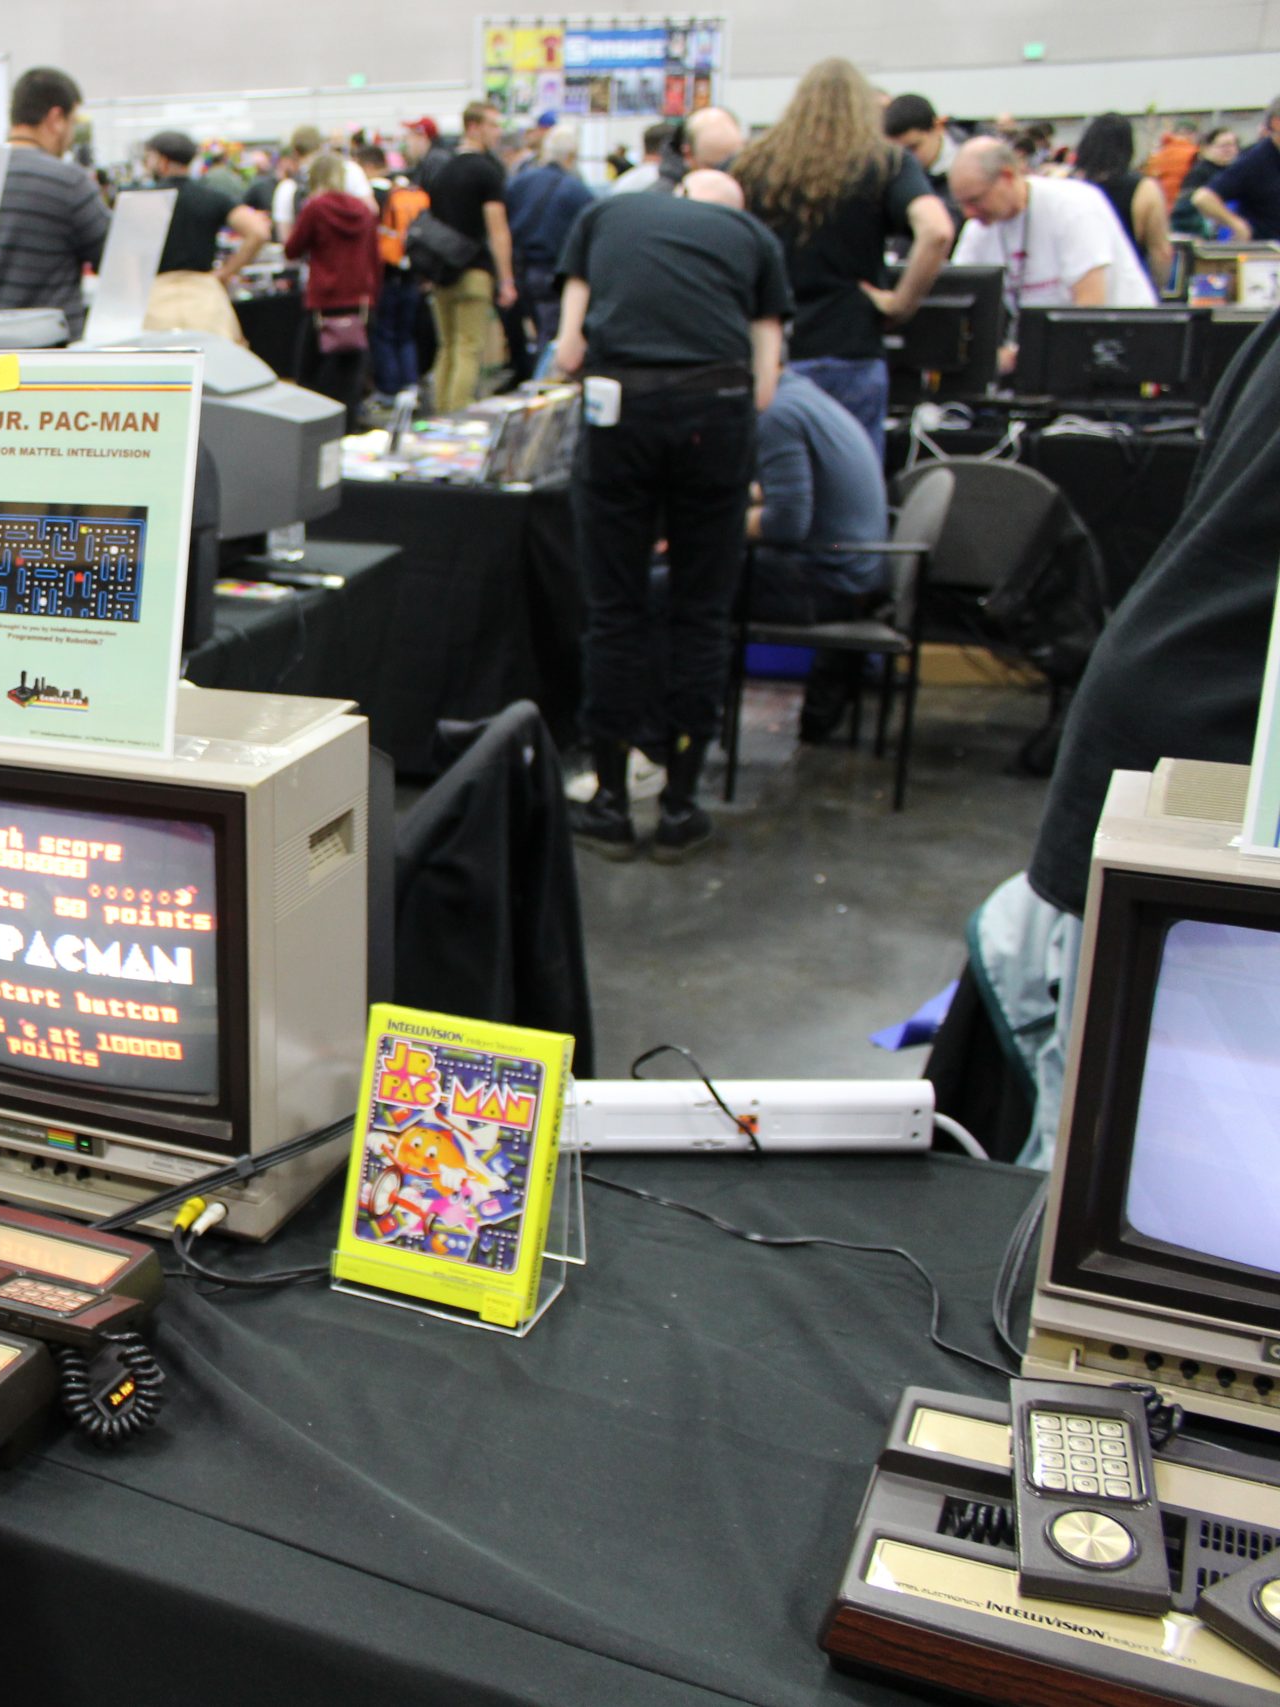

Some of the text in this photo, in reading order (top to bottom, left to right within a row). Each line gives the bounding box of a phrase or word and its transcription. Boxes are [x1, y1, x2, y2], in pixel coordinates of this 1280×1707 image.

[39, 411, 160, 432] PAC-MAN
[20, 446, 63, 458] MATTEL
[67, 447, 151, 459] INTELLIVISION
[7, 633, 53, 642] Programmed
[55, 636, 63, 644] by
[40, 836, 122, 861] score
[54, 896, 212, 931] 50 points
[74, 991, 179, 1024] button
[6, 1036, 100, 1068] points
[48, 1027, 81, 1047] at
[96, 1032, 184, 1061] 10000
[382, 1041, 439, 1080] JR.
